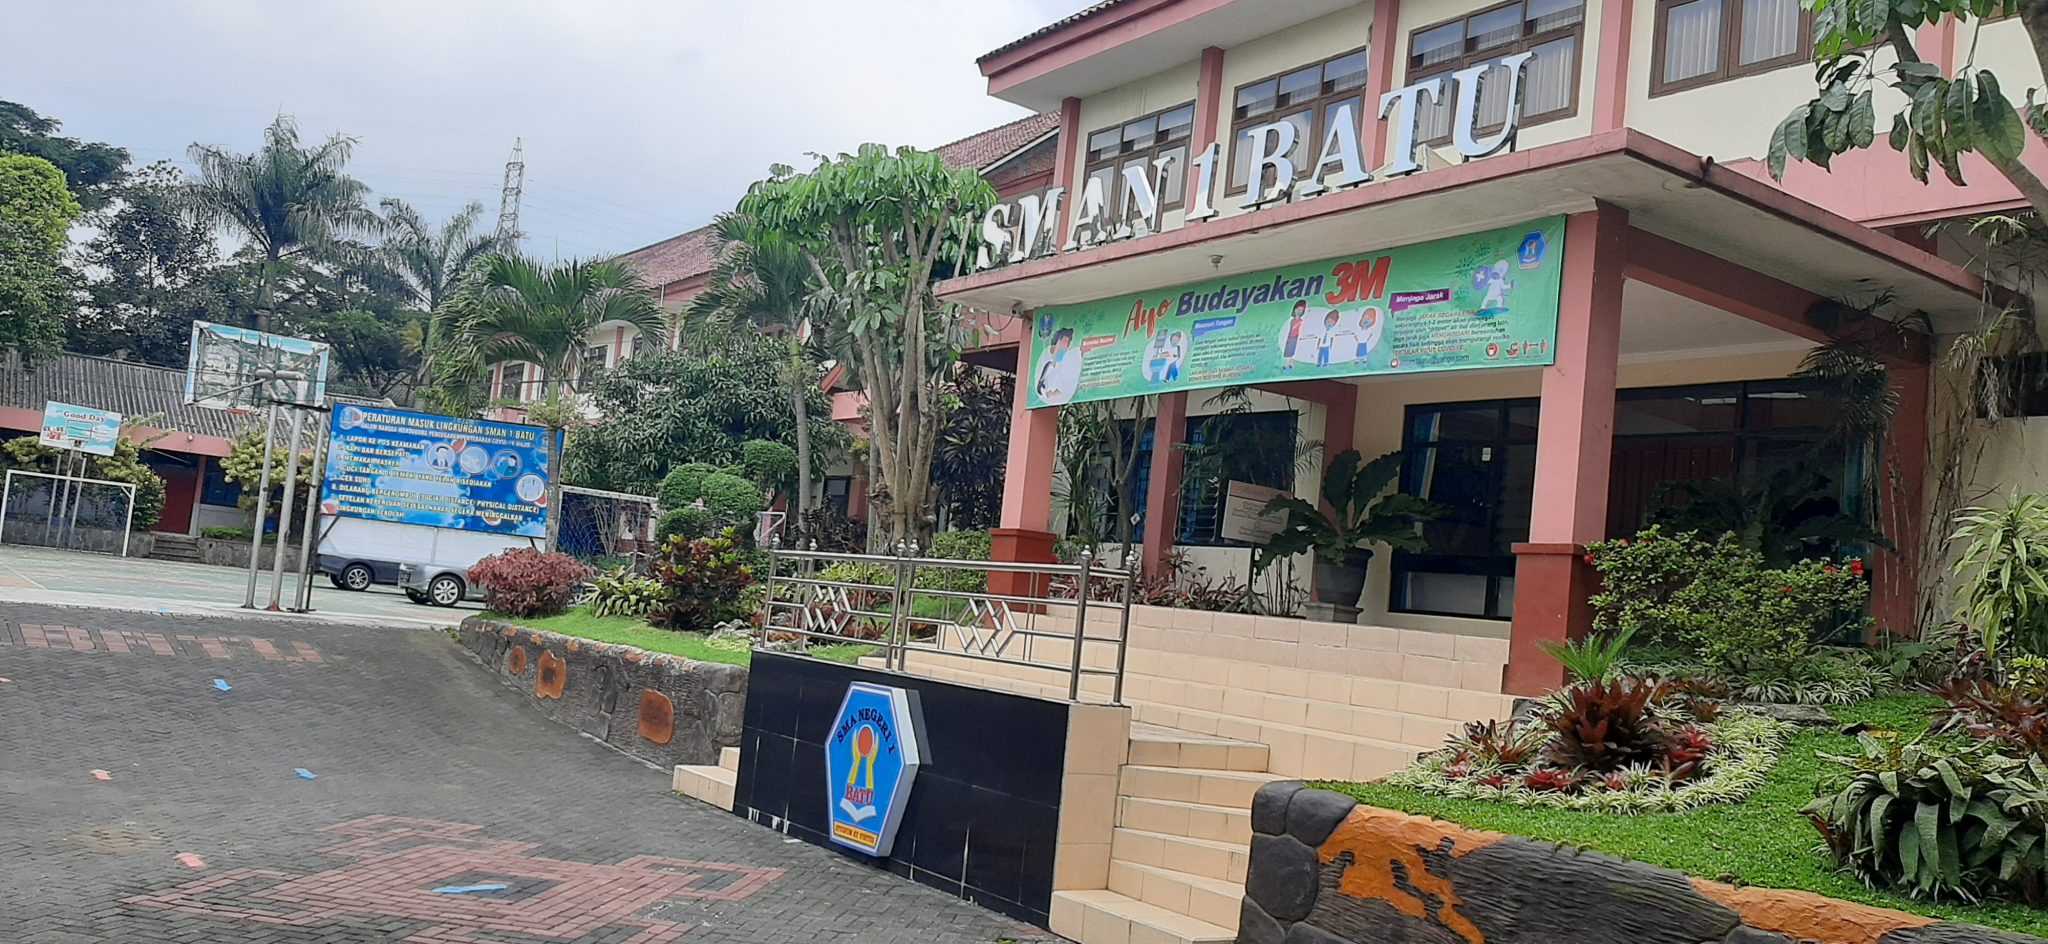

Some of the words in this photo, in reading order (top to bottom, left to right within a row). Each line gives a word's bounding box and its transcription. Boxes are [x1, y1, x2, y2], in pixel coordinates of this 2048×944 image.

[976, 155, 1176, 270] SMAN
[1186, 142, 1220, 221] 1
[1240, 51, 1536, 209] BATU
[1122, 298, 1173, 340] Ayo
[1175, 274, 1324, 317] Budayakan
[1325, 256, 1392, 305] 3M
[63, 410, 87, 420] Good
[88, 414, 105, 423] Day
[362, 411, 406, 425] PERATURAN
[408, 416, 434, 429] MASUK
[436, 421, 483, 434] LINGKUNGAN
[485, 427, 507, 437] SMAN
[515, 431, 535, 441] BATU
[836, 713, 858, 744] SMA
[858, 707, 893, 742] NEGERI
[845, 783, 875, 806] BATU
